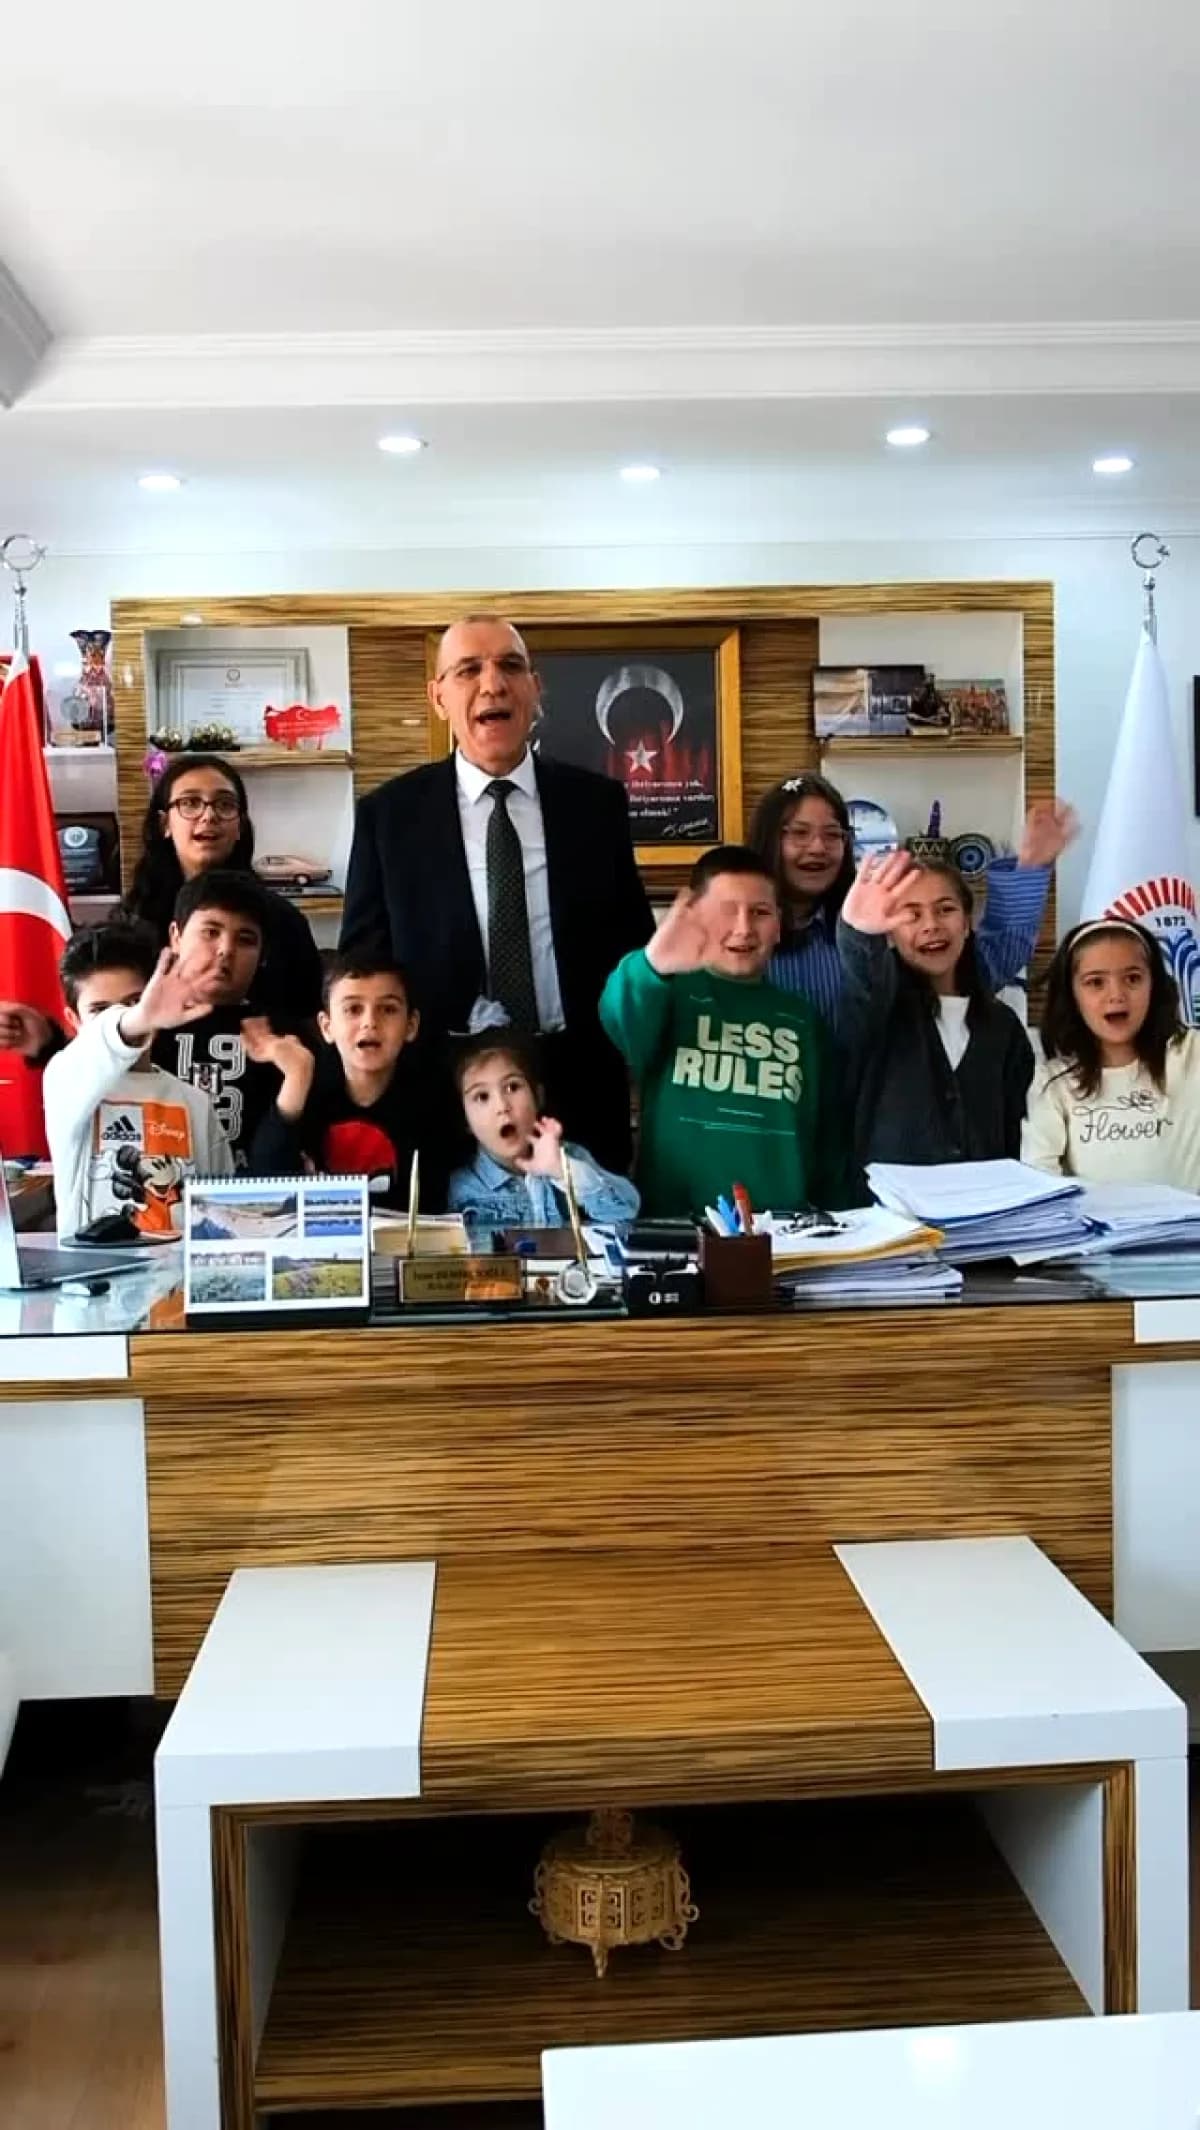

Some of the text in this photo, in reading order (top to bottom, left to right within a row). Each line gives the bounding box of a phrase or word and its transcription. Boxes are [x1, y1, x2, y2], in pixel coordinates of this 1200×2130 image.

[175, 1032, 247, 1081] 19
[697, 1014, 800, 1064] LESS
[672, 1046, 804, 1105] RULES
[1079, 1108, 1174, 1143] Flower
